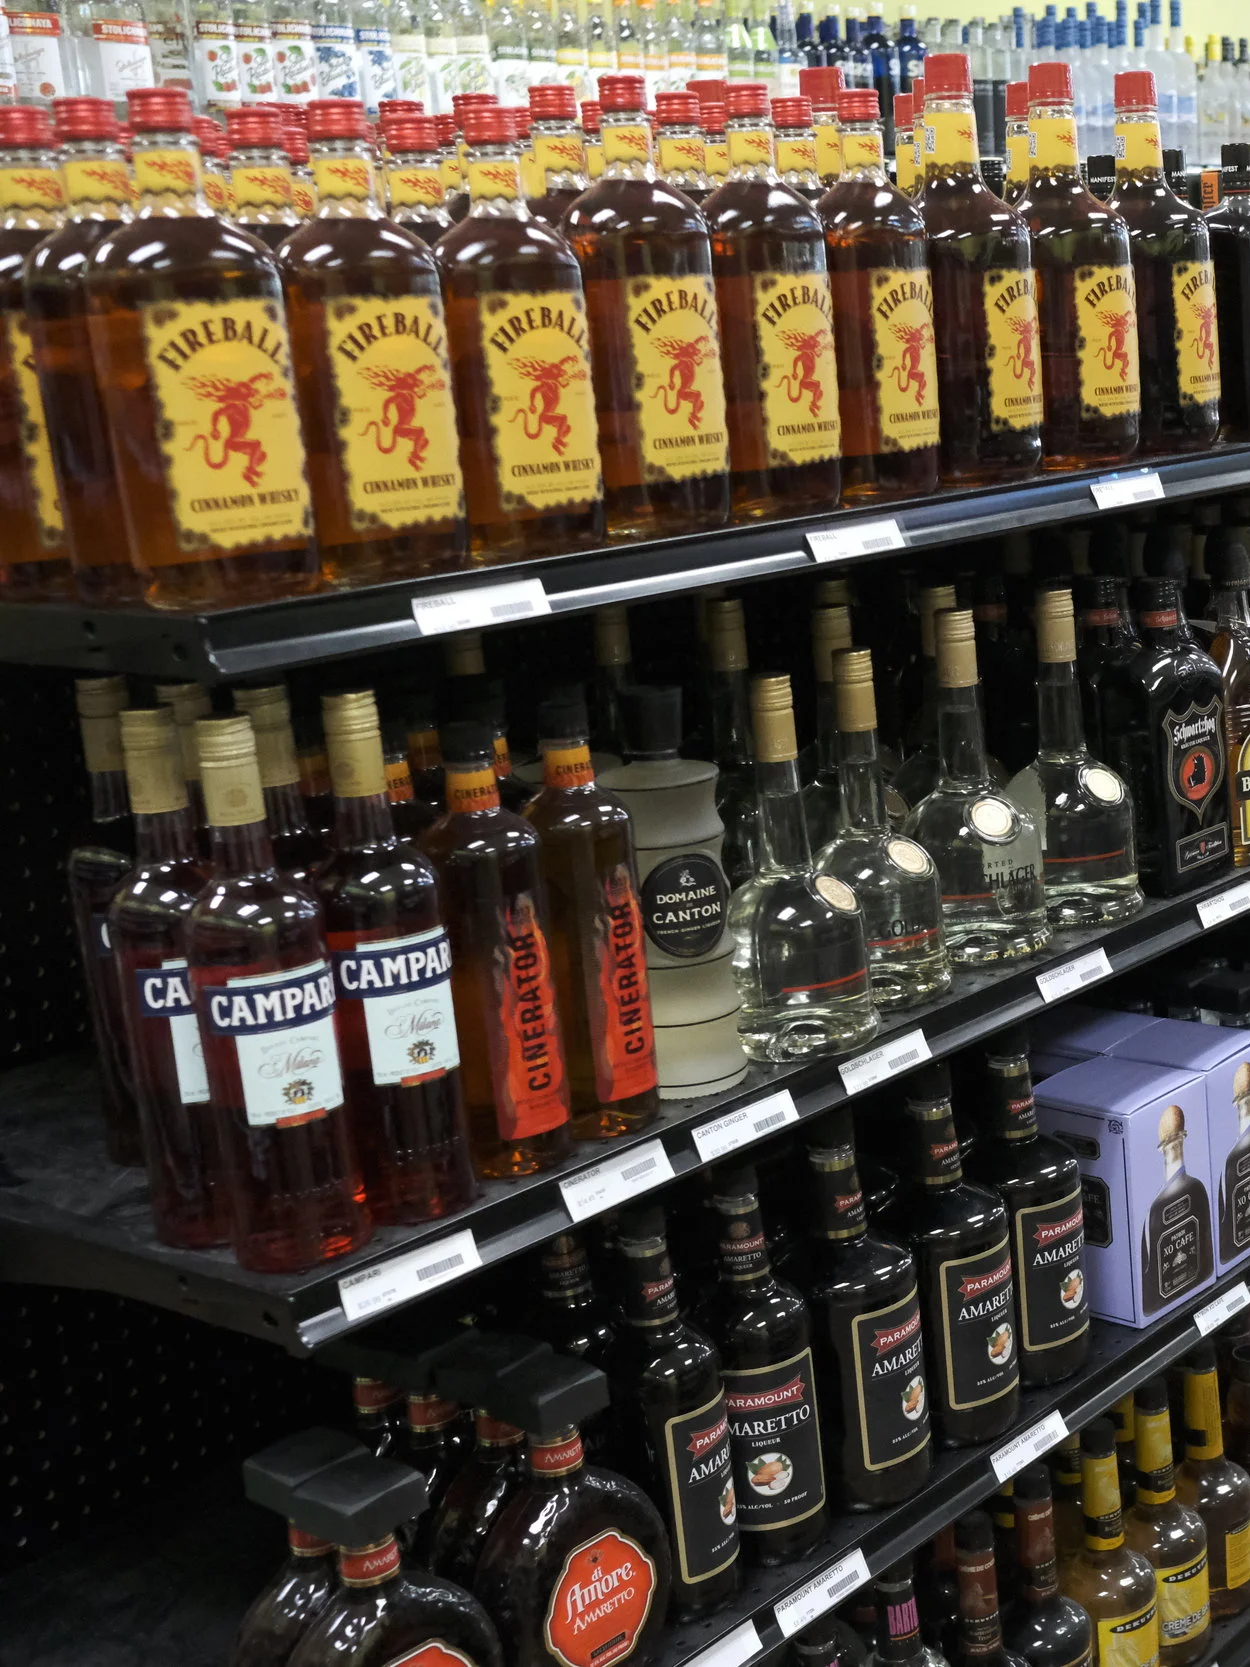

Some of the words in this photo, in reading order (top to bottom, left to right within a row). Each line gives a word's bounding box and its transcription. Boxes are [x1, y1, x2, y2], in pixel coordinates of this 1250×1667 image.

[337, 312, 444, 363] FIREBALL
[490, 306, 588, 354] FIREBALL
[157, 316, 286, 373] FIREBALL
[1094, 385, 1125, 397] CINNAMON
[889, 410, 921, 425] CINNAMON
[653, 434, 697, 450] CINNAMON
[698, 432, 724, 446] WHISKY
[777, 422, 815, 437] CINNAMON
[511, 460, 561, 478] CINNAMON
[563, 458, 596, 473] WHISKY
[363, 476, 419, 495] CINNAMON
[421, 473, 456, 488] WHISKY
[190, 491, 256, 514] CINNAMON
[259, 488, 300, 507] WHISKY
[656, 885, 717, 904] DOMAINE
[652, 901, 721, 924] CANTON
[339, 938, 452, 991] CAMPAR
[1039, 965, 1076, 986] GOLDSCHLAGER
[611, 901, 646, 1055] CINERATOR
[210, 970, 334, 1027] CAMPAR
[512, 930, 551, 1092] CINERATOR
[840, 1050, 884, 1076] GOLDSCHLAGER
[696, 1123, 723, 1139] CANTON
[724, 1112, 748, 1128] GINGER
[563, 1167, 600, 1189] CINERATOR
[1237, 1194, 1247, 1207] XO
[1163, 1243, 1174, 1257] XO
[1175, 1231, 1194, 1249] CAFE
[724, 1251, 762, 1264] AMARETTO
[341, 1267, 383, 1290] CAMPARI
[724, 1385, 800, 1408] ARAMOUNT
[727, 1405, 810, 1437] MARETTO
[696, 1418, 728, 1449] PARAM
[751, 1438, 781, 1448] LIQUEUR
[992, 1441, 1021, 1464] PARAMOUNT
[1020, 1423, 1046, 1445] AMARETTO
[544, 1441, 583, 1463] AMARETT
[791, 1491, 808, 1503] PROOF
[591, 1566, 603, 1583] di
[776, 1585, 813, 1614] PARAMOUNT
[813, 1564, 844, 1590] AMARETTO
[573, 1586, 635, 1635] AMARETTO
